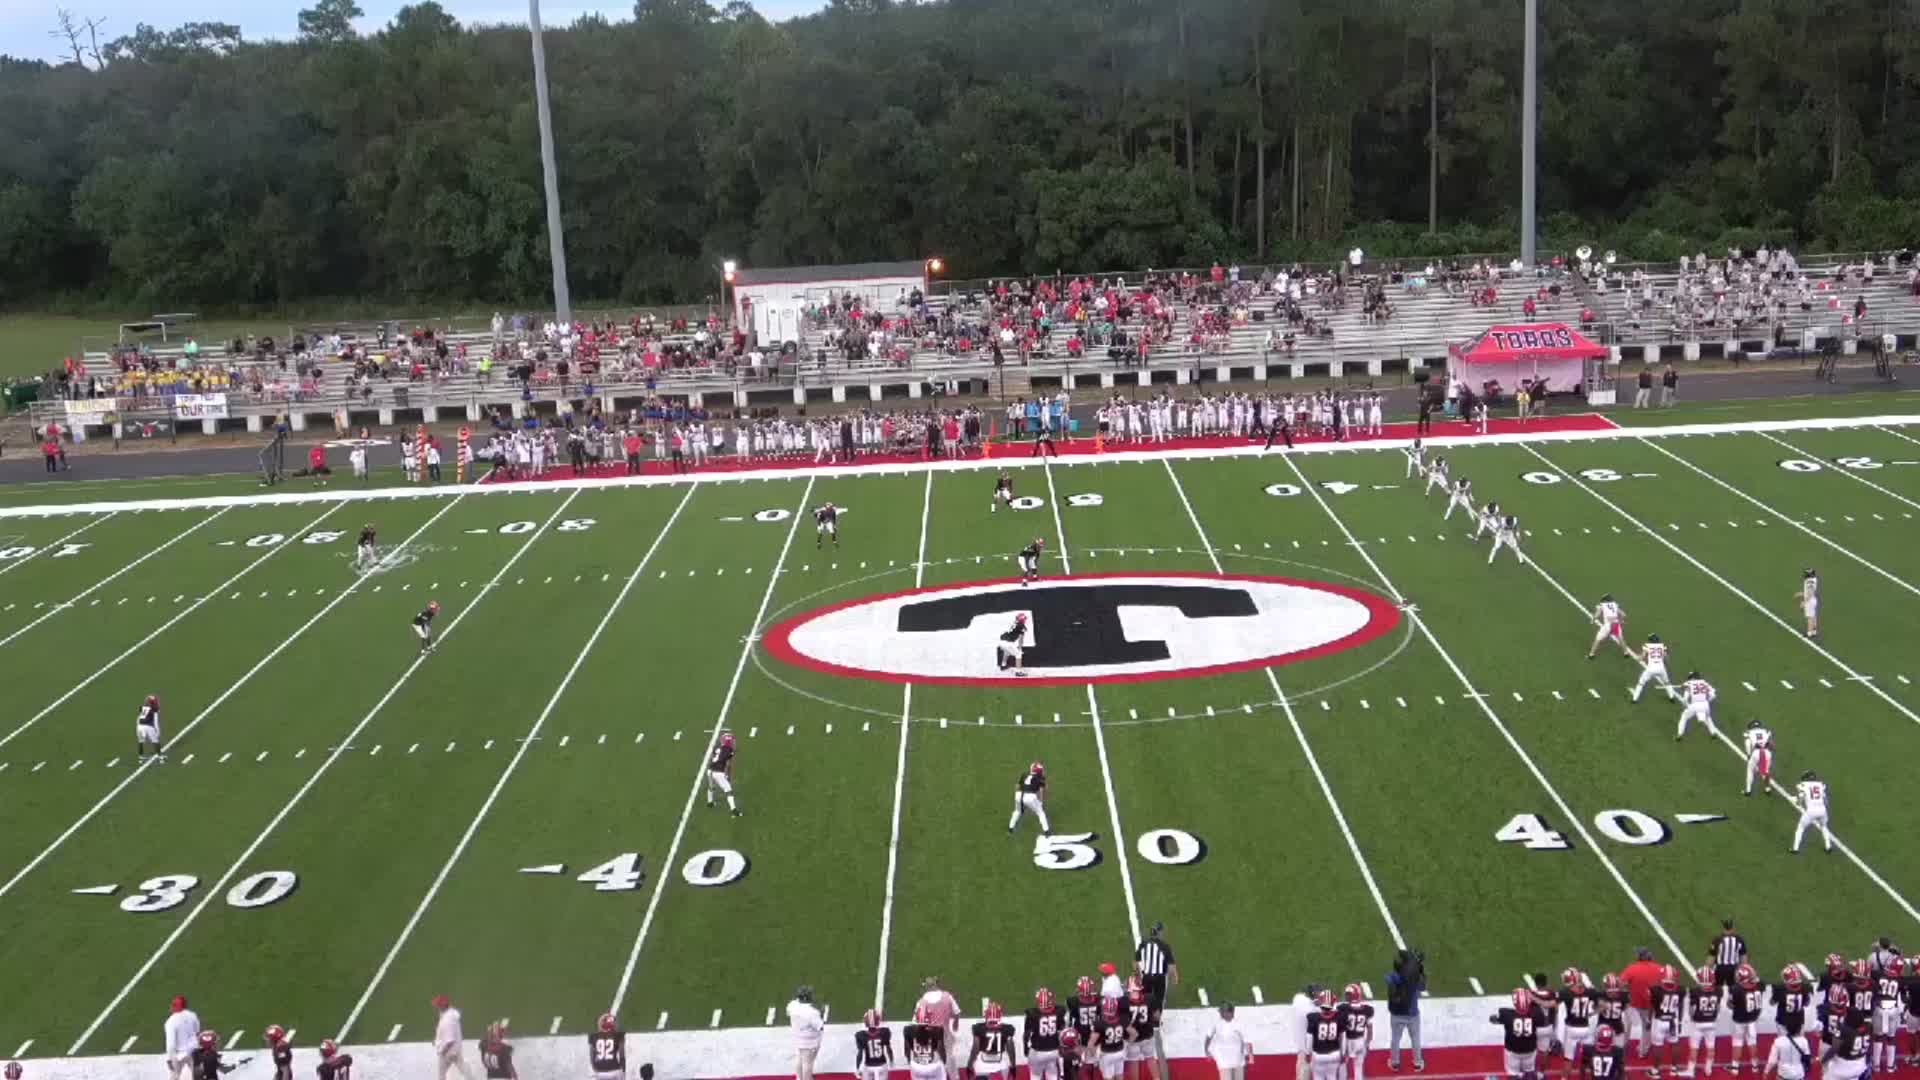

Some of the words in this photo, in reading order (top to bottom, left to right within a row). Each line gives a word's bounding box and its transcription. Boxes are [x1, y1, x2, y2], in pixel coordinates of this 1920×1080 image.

[1492, 330, 1574, 350] TOROS
[1786, 994, 1803, 1013] 51
[1128, 1004, 1149, 1023] 73
[1318, 1022, 1338, 1041] 88
[1346, 1014, 1366, 1033] 32
[1512, 1018, 1533, 1038] 99
[595, 1038, 615, 1060] 92
[866, 1040, 883, 1059] 15
[985, 1032, 1002, 1052] 71
[1592, 1056, 1614, 1077] 97
